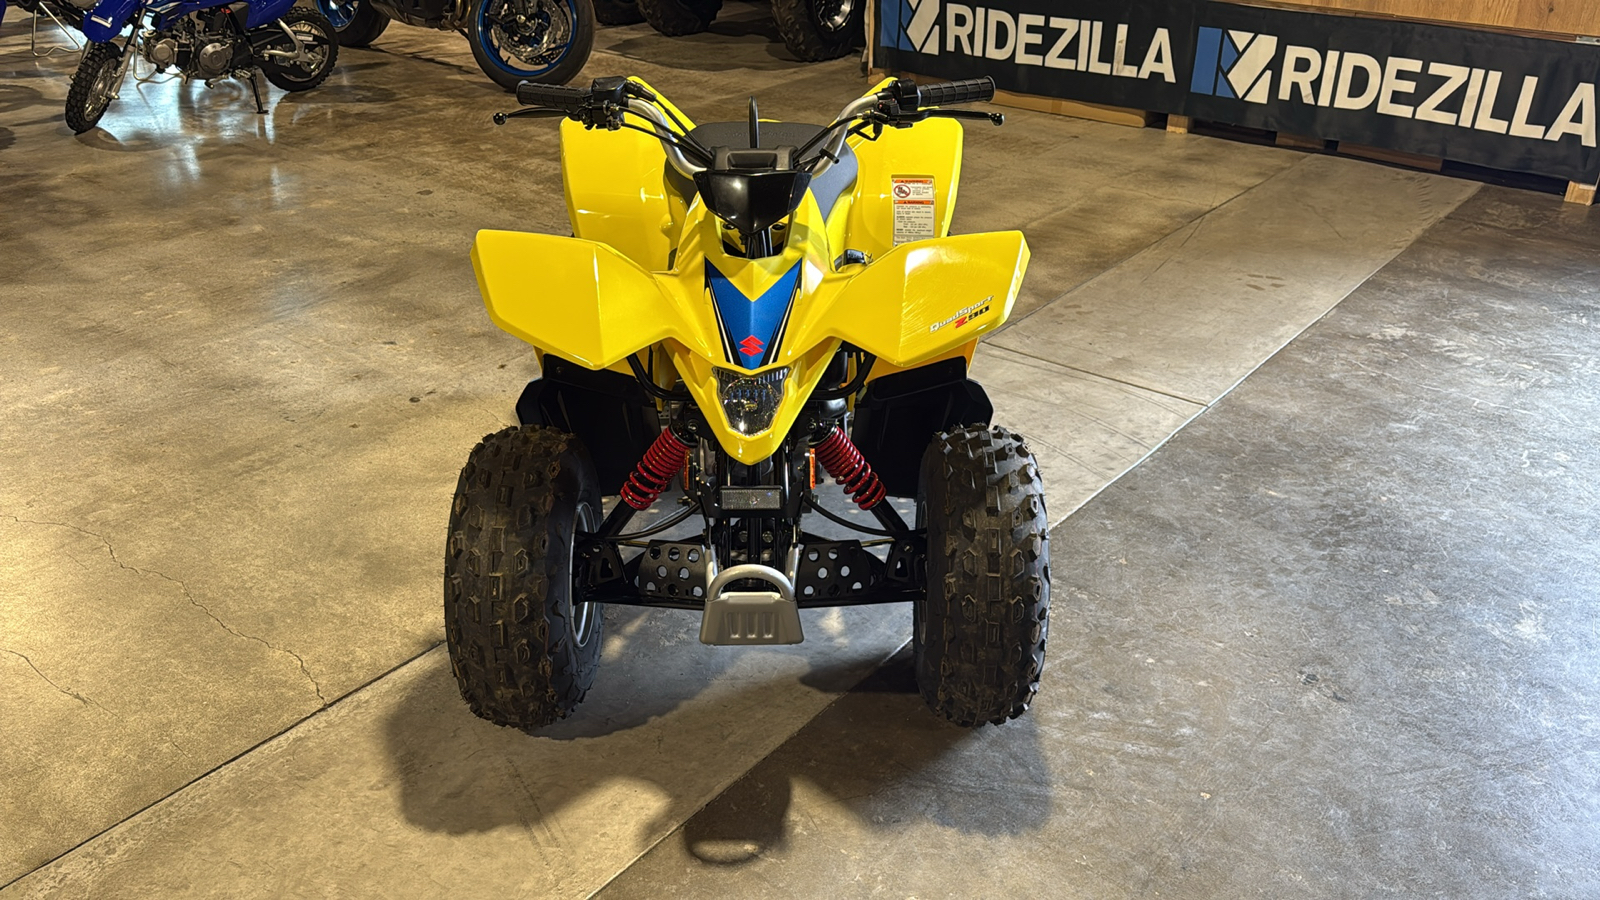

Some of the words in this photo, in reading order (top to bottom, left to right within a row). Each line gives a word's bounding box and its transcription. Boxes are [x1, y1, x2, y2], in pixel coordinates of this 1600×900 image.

[946, 3, 1176, 83] RIDEZILLA
[1278, 44, 1596, 147] RIDEZILLA
[954, 305, 990, 329] Z90
